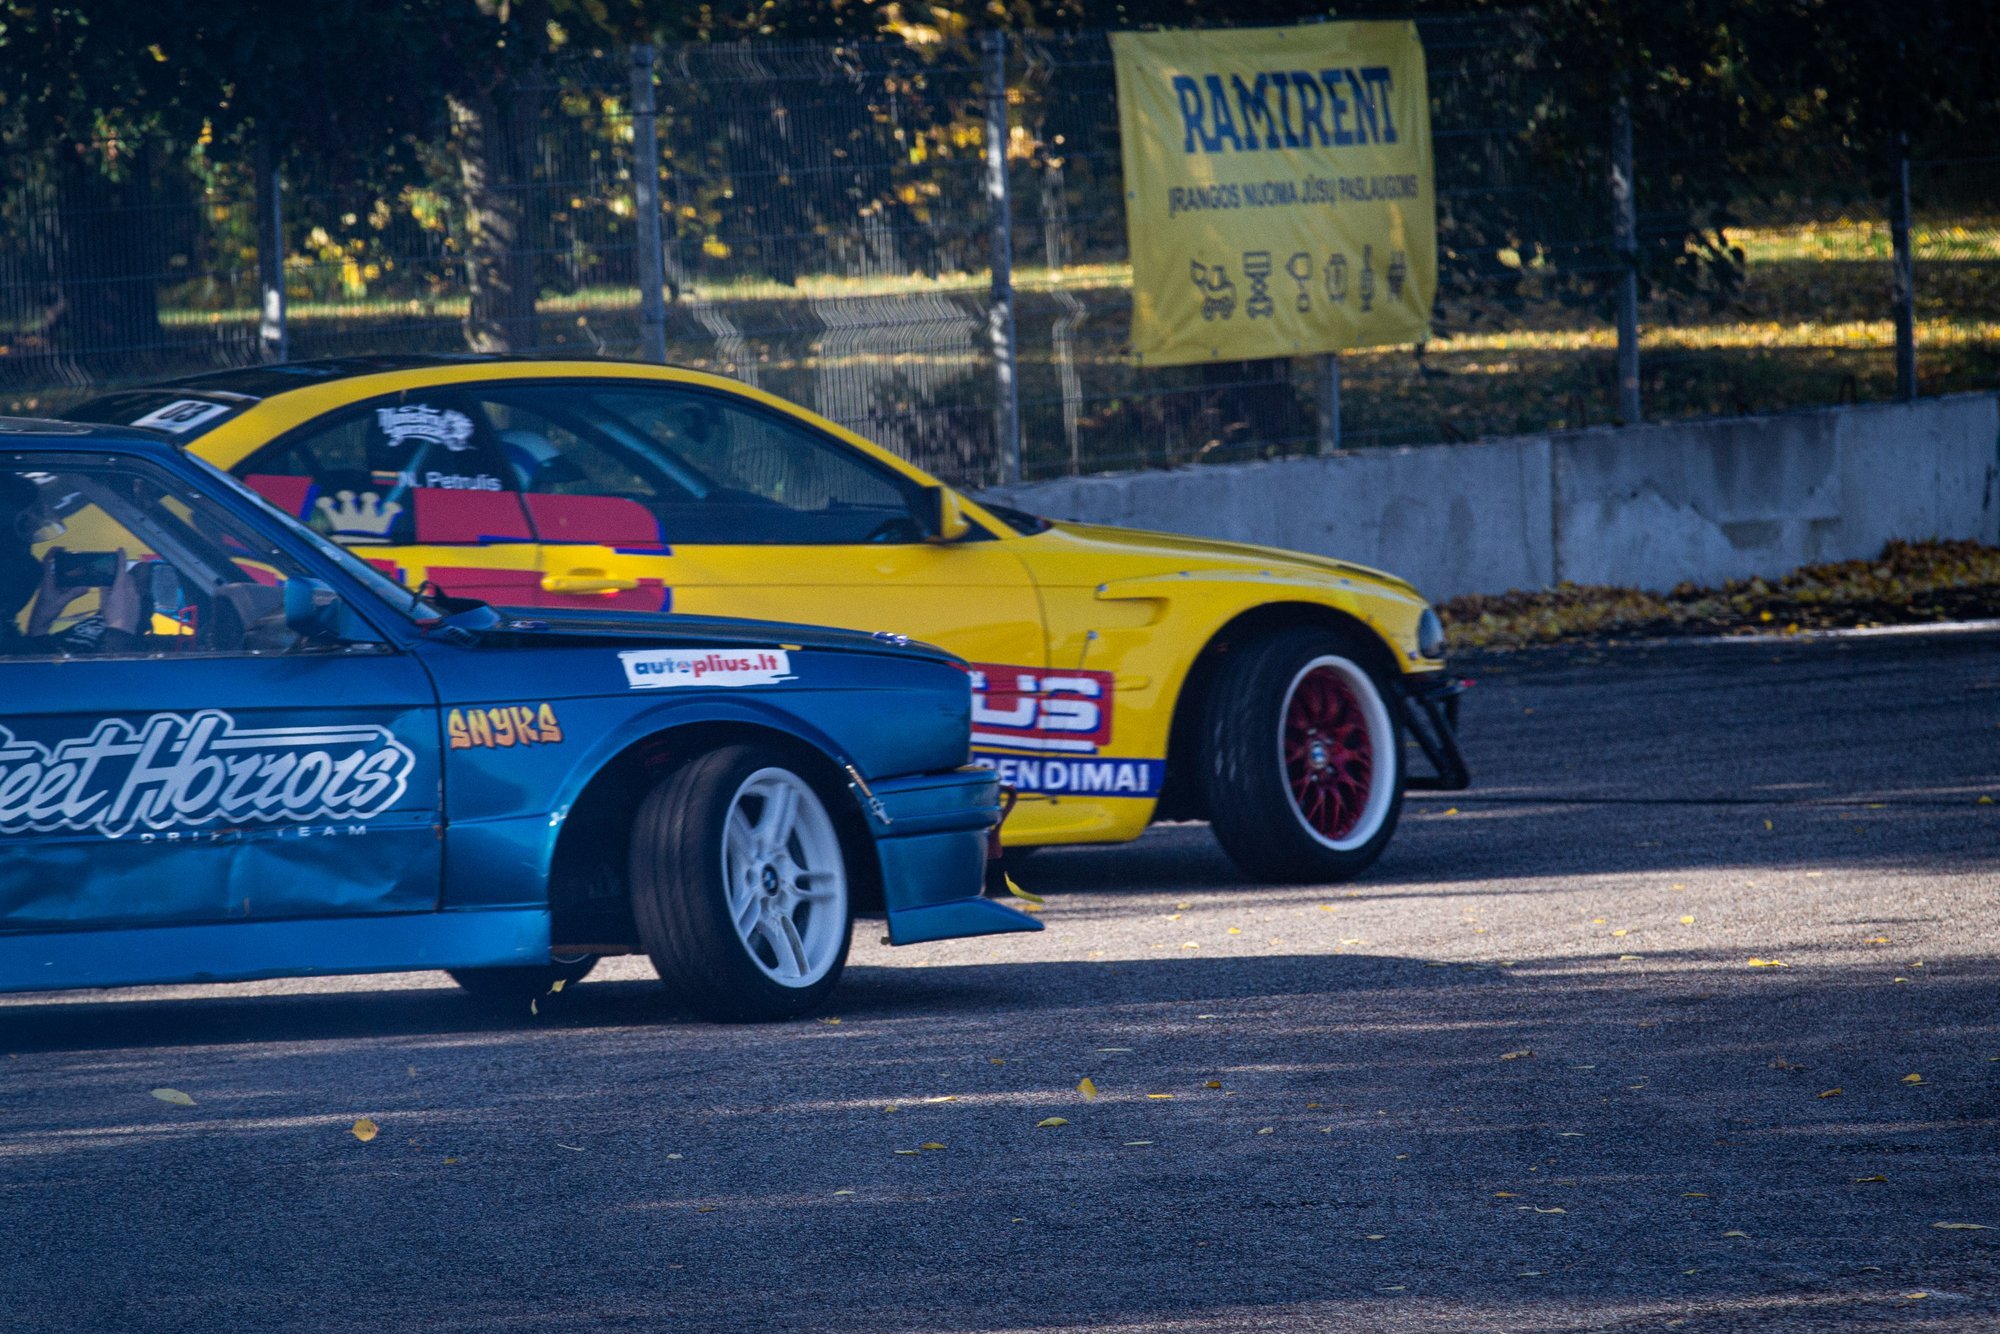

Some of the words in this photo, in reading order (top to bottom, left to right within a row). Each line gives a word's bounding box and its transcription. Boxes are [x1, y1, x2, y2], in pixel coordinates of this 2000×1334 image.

[1172, 66, 1398, 153] RAMIRENT
[157, 403, 214, 422] 03
[425, 471, 502, 491] Petrulis
[634, 654, 778, 678] autoplius.lt
[968, 670, 1100, 732] US
[0, 726, 143, 822] eet
[105, 714, 400, 826] Horrors
[276, 825, 367, 837] TEAM
